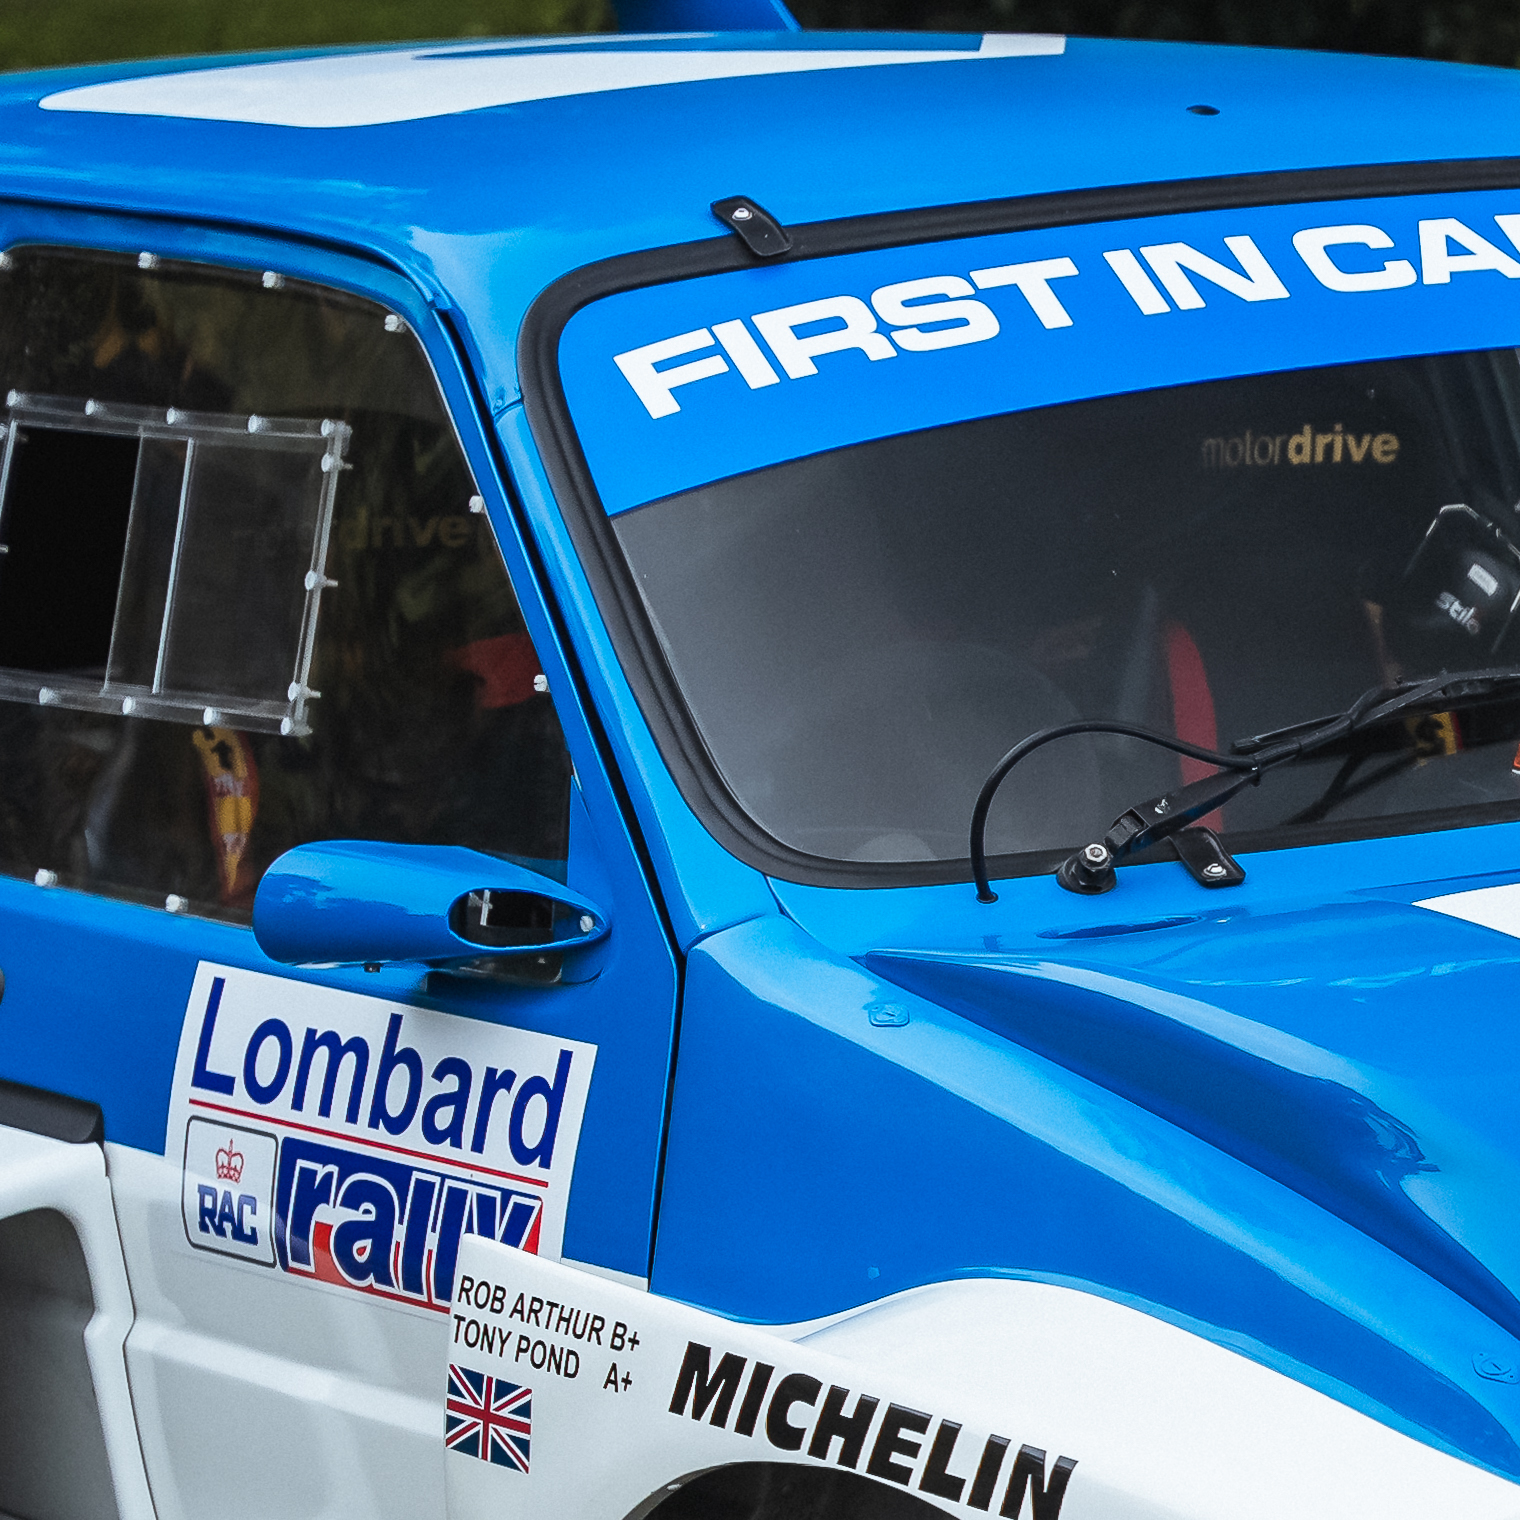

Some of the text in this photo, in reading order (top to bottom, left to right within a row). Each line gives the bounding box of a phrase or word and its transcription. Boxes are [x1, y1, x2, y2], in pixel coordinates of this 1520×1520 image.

[613, 257, 1079, 420] FIRST
[1102, 235, 1291, 316] IN
[1202, 424, 1400, 466] motordrive
[191, 976, 573, 1170] Lombard
[197, 1183, 259, 1246] RAC
[453, 1313, 634, 1393] TONY POND A+
[457, 1274, 641, 1354] ROB ARTHUR B+
